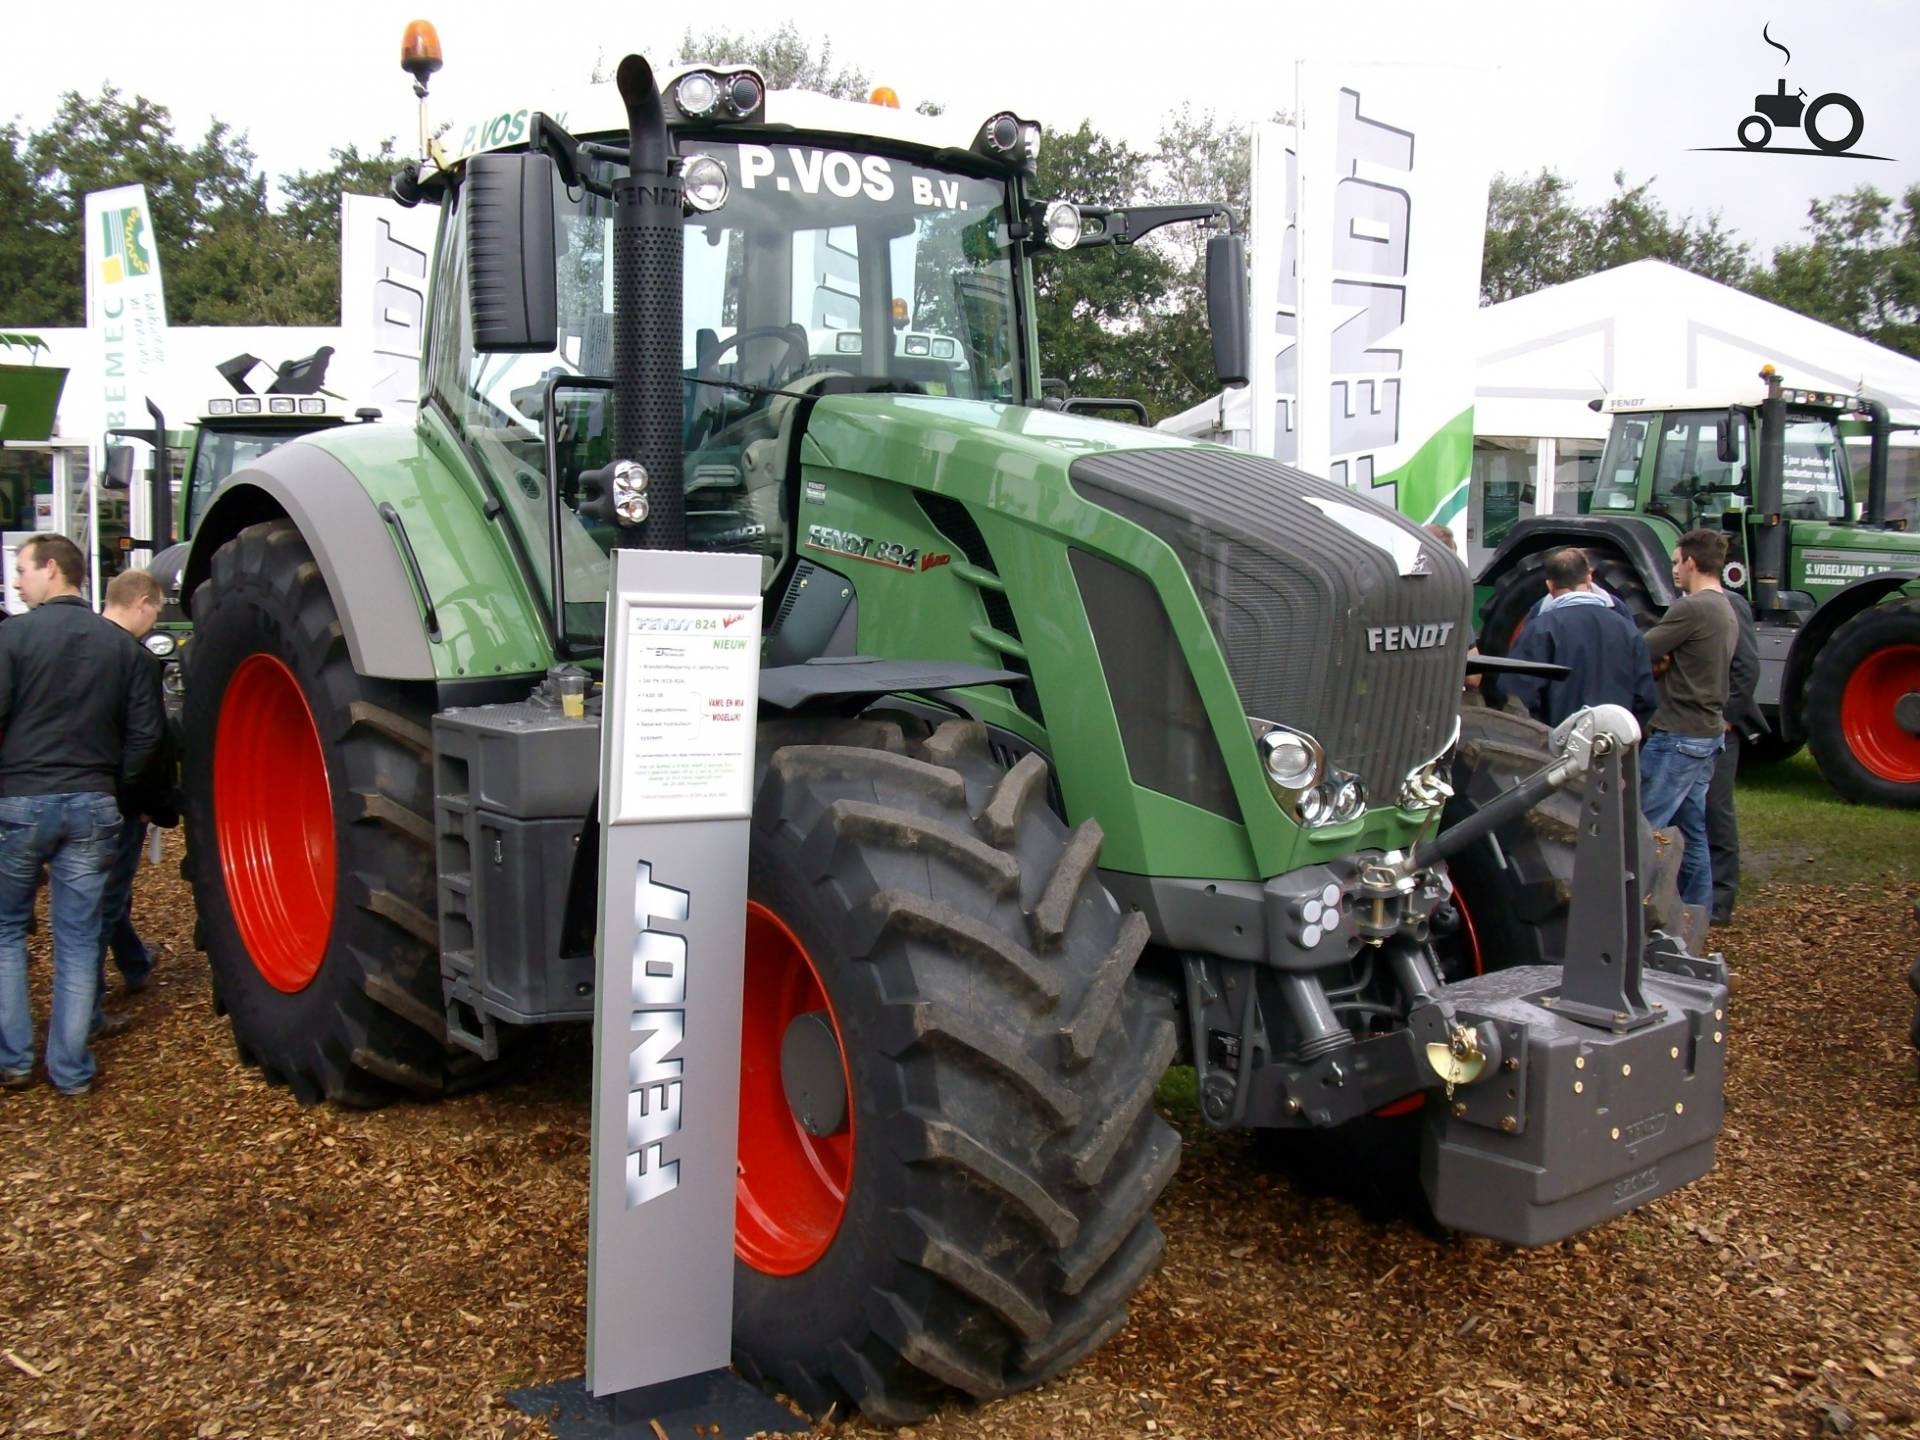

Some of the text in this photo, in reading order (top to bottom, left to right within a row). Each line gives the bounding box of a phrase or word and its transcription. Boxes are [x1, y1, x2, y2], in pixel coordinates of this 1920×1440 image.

[459, 109, 528, 157] P.VOS
[738, 143, 968, 211] P.VOS B.V.
[1330, 86, 1415, 507] FENDT
[1610, 398, 1646, 409] FENDT
[808, 523, 875, 558] FENDT
[874, 540, 920, 568] 824
[1805, 563, 1865, 577] S.VOGELZANG
[695, 619, 717, 630] 824
[1366, 622, 1455, 652] FENDT
[713, 639, 748, 650] NIEUW
[626, 858, 690, 1211] FENDT
